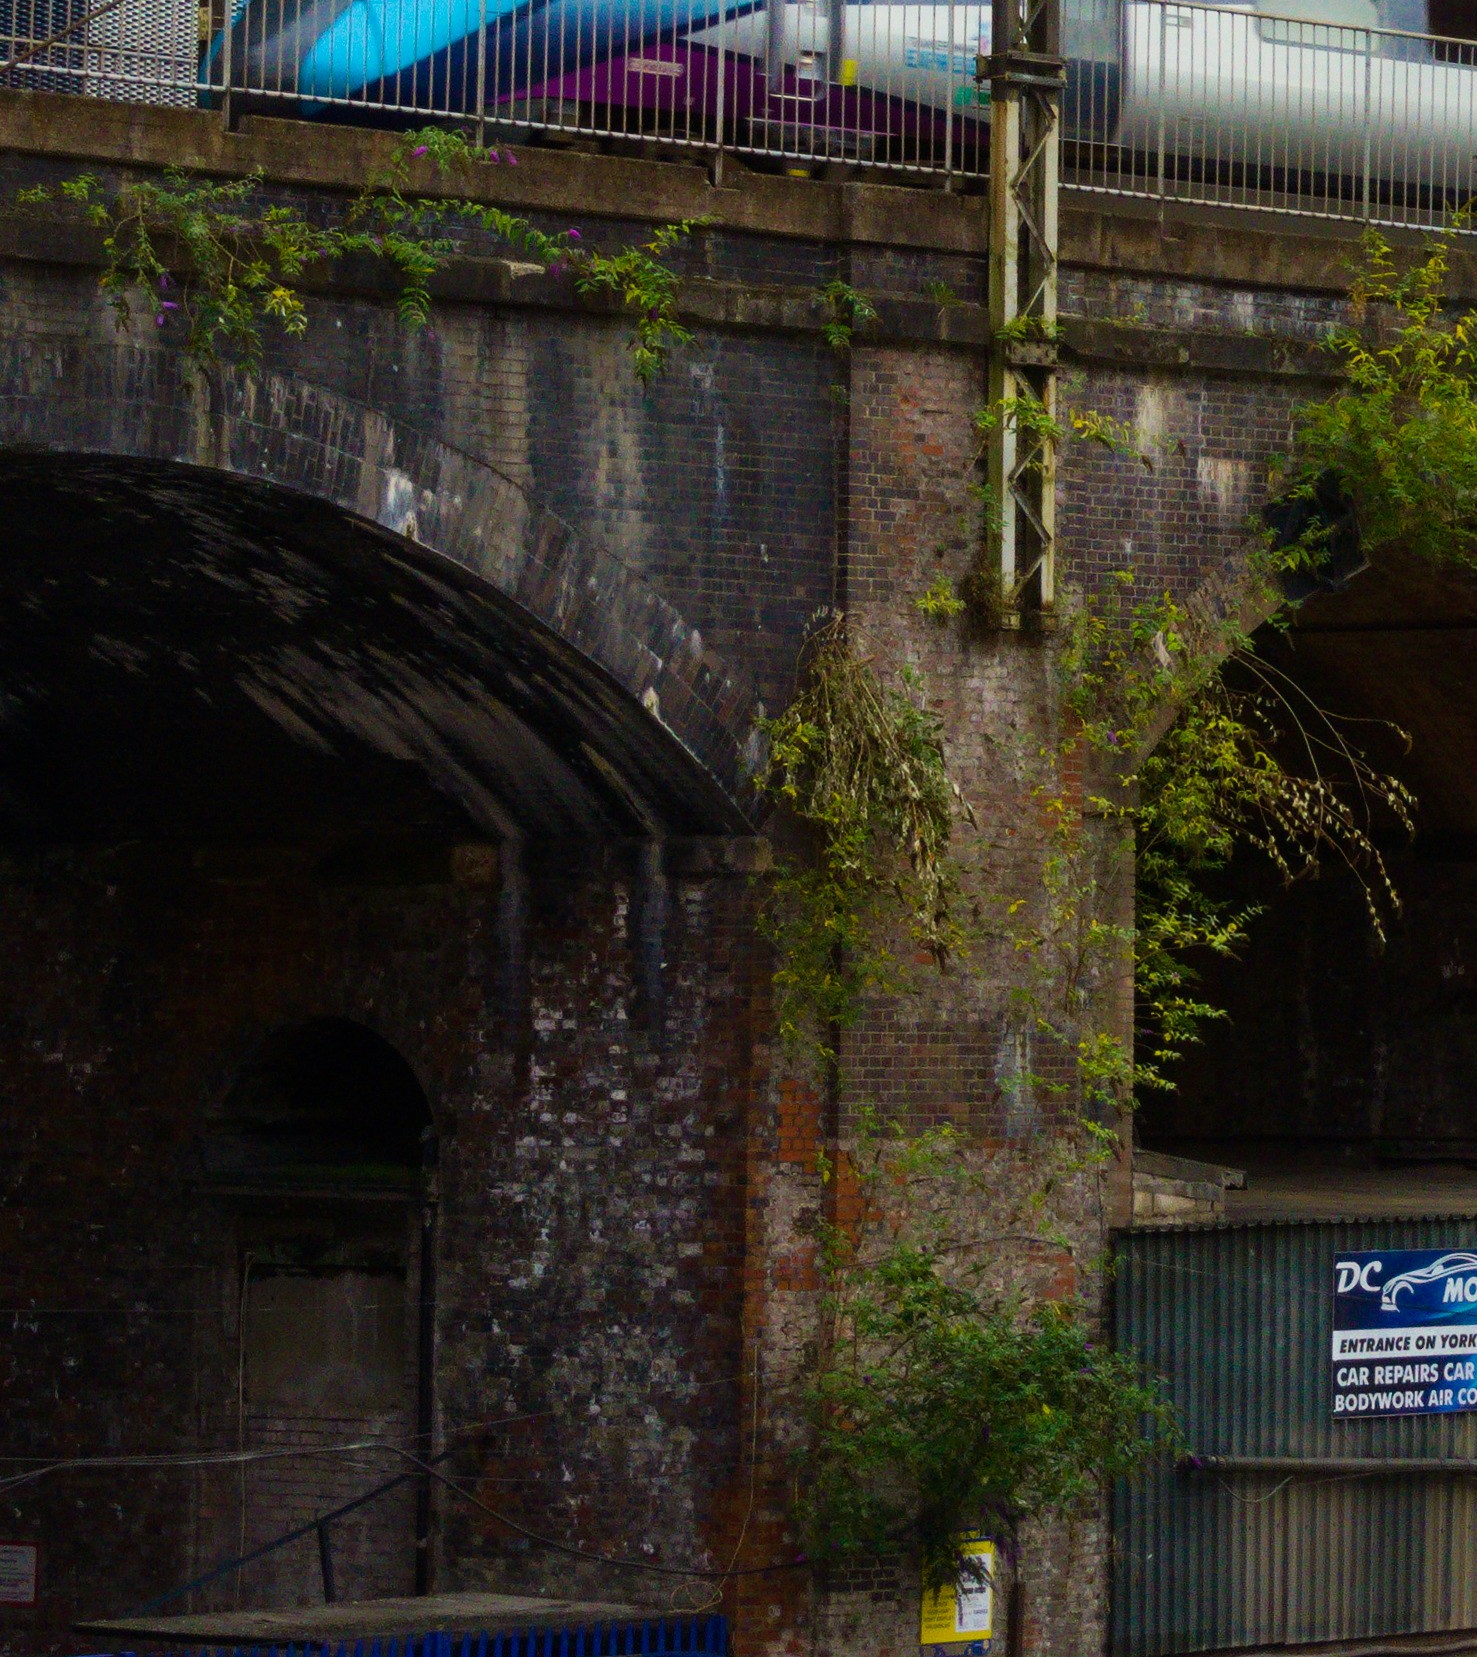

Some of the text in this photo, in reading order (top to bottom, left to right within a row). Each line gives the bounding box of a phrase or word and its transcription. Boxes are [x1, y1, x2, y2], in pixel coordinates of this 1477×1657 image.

[1335, 1260, 1382, 1293] DC
[1340, 1336, 1411, 1354] ENTRANCE
[1415, 1335, 1436, 1351] ON
[1440, 1333, 1477, 1349] YORK
[1337, 1366, 1369, 1387] CAR
[1374, 1363, 1439, 1386] REPAIRS
[1444, 1362, 1475, 1382] CAR
[1335, 1390, 1425, 1412] BODYWORK
[1427, 1389, 1454, 1407] AIR
